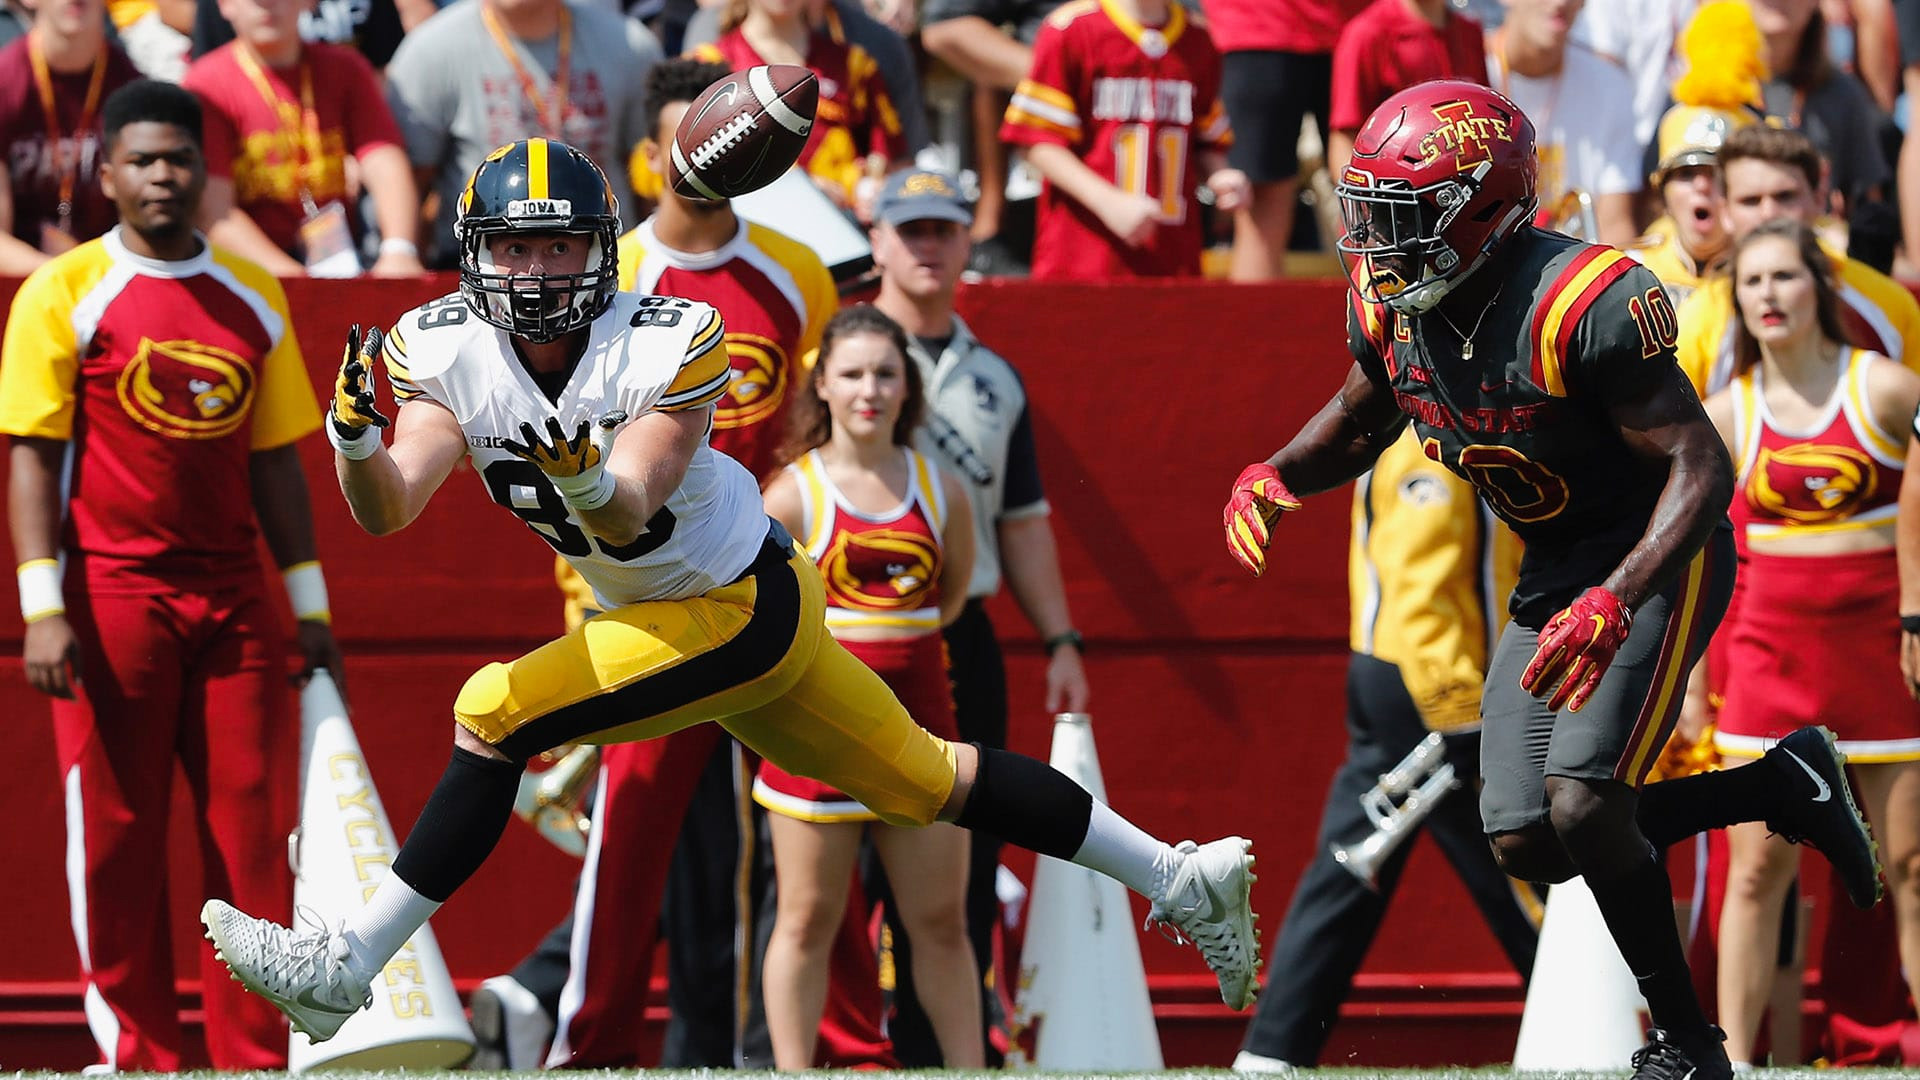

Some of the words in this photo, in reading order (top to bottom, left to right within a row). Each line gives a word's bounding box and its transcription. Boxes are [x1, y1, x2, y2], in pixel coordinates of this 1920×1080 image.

[1418, 118, 1512, 166] STATE
[1112, 123, 1188, 226] 11
[522, 202, 556, 214] IOWA
[1628, 286, 1678, 360] 10
[1392, 385, 1457, 433] IOWA
[1461, 402, 1550, 434] STAT
[328, 753, 433, 1021] CYCLES
